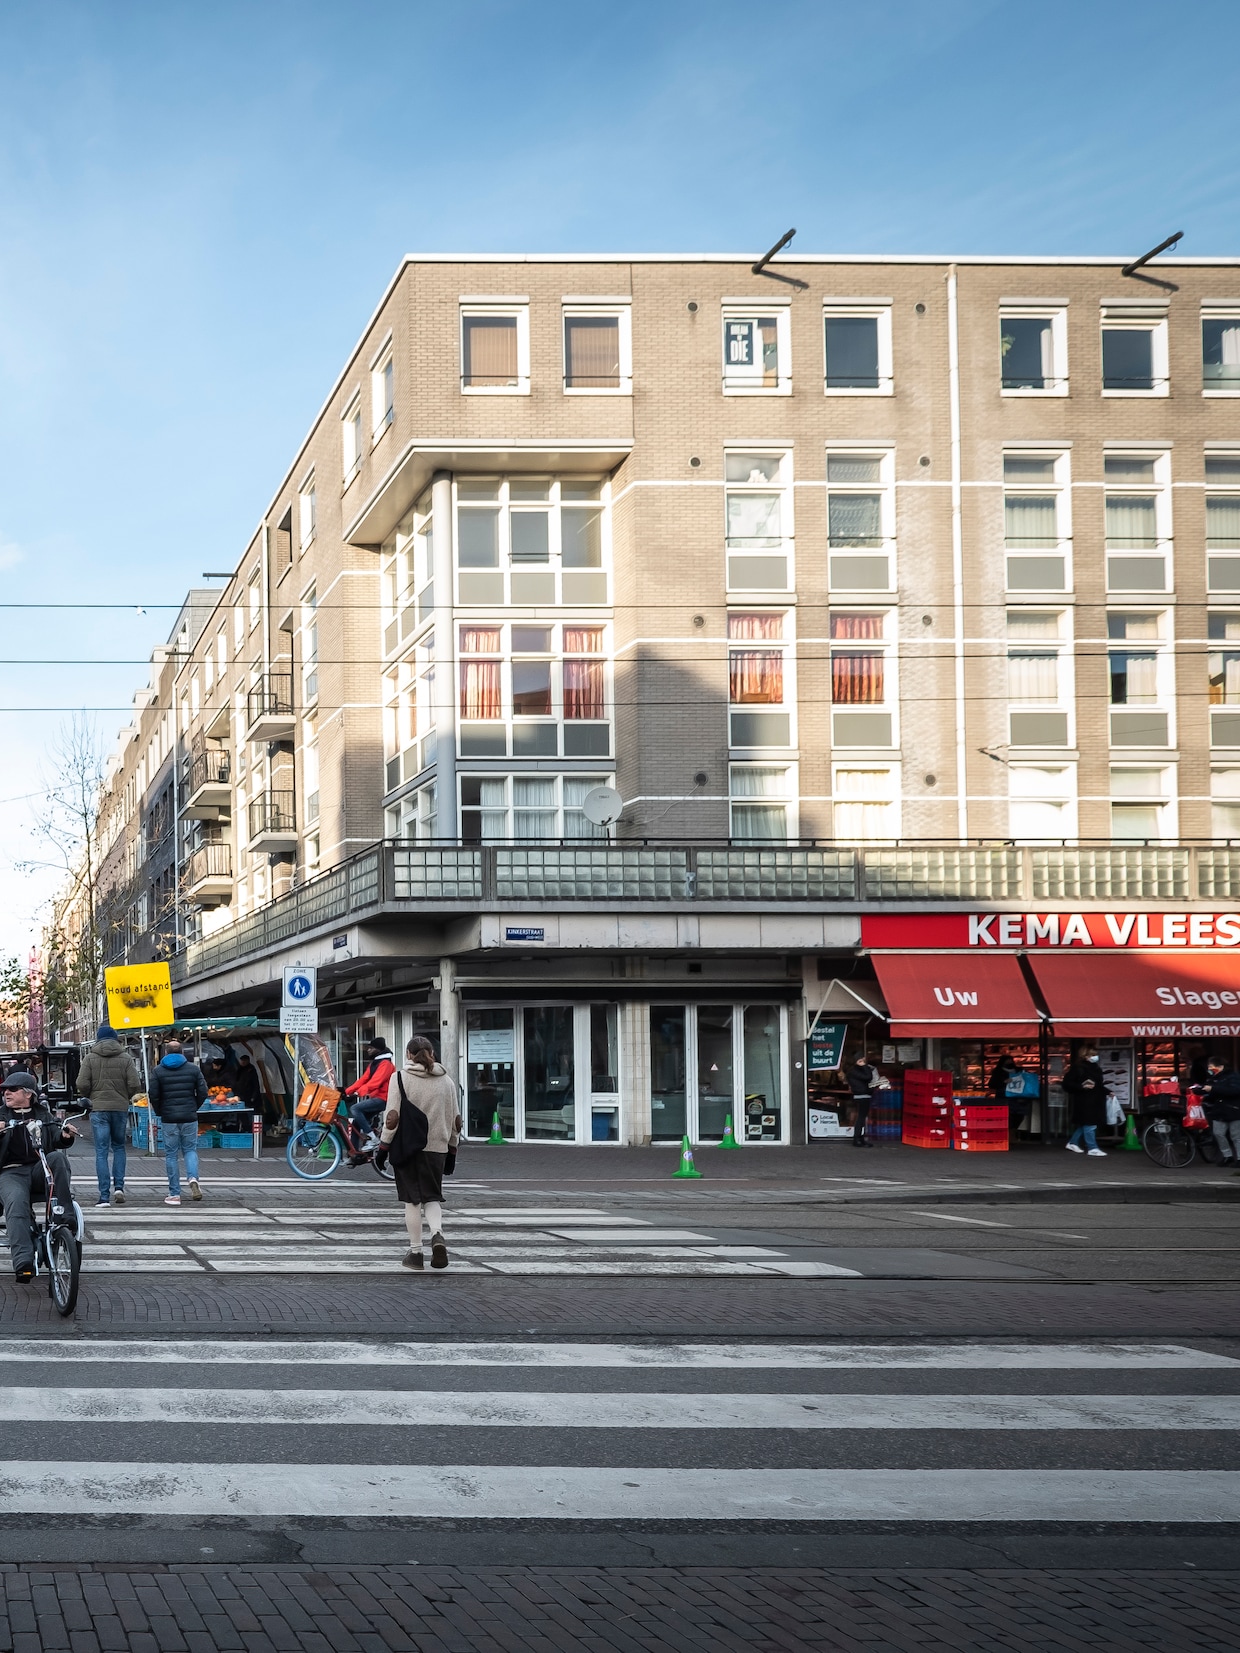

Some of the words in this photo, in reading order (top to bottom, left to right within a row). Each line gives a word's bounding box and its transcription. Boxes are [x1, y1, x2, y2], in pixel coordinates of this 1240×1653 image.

[730, 340, 749, 362] DIE
[968, 913, 1093, 946] KEMA
[1104, 913, 1240, 946] VLEES
[108, 985, 131, 994] Houd
[134, 982, 169, 993] afstand
[934, 987, 978, 1006] Uw
